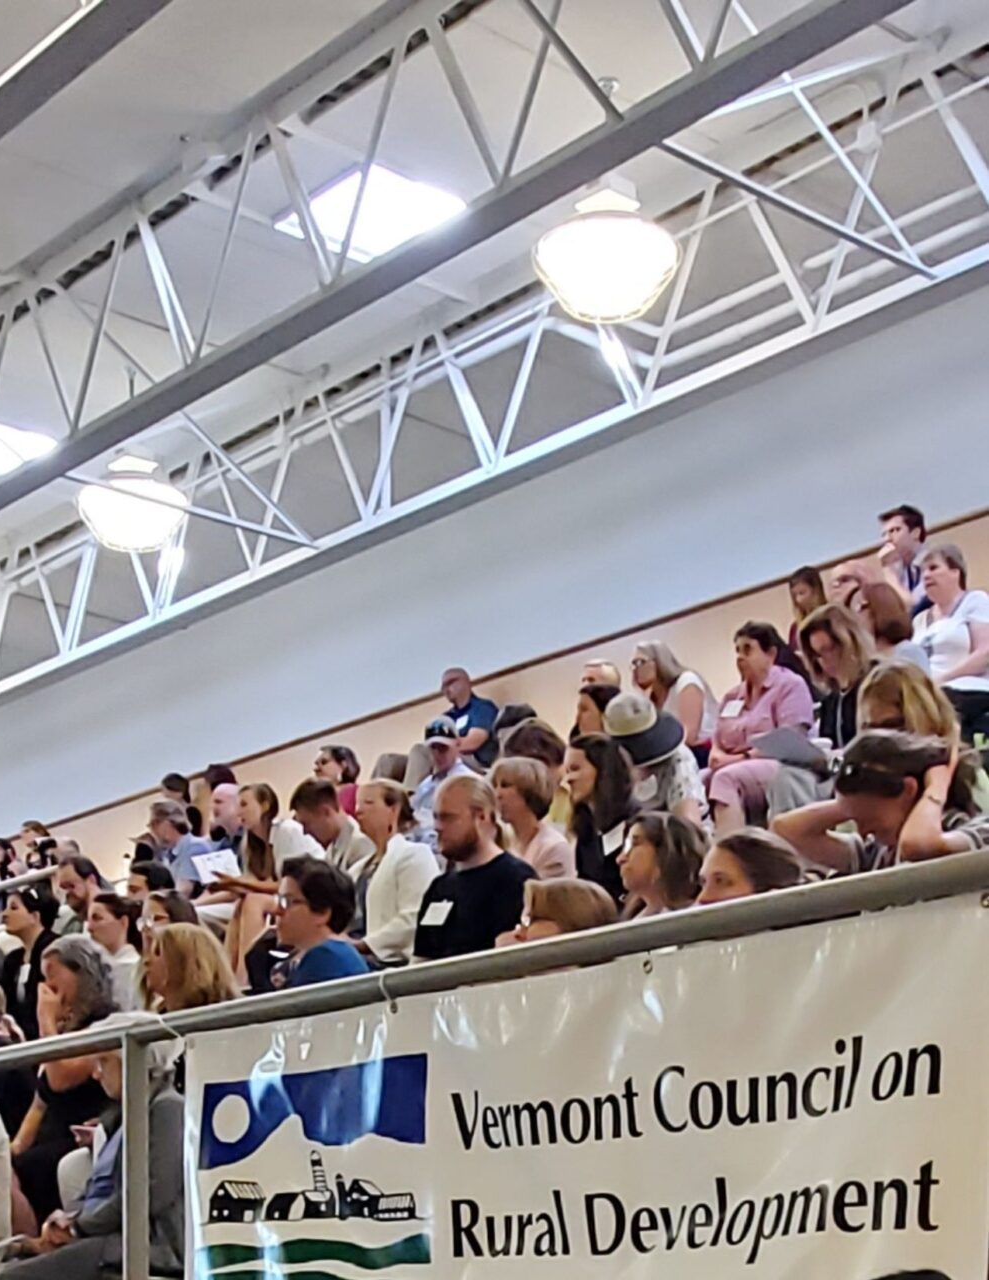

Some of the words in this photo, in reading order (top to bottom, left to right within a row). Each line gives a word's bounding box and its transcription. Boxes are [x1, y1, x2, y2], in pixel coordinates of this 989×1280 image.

[451, 1078, 639, 1151] Vermont
[654, 1036, 863, 1134] Council
[872, 1043, 943, 1103] on
[452, 1190, 571, 1259] Rural
[586, 1160, 941, 1265] Development
